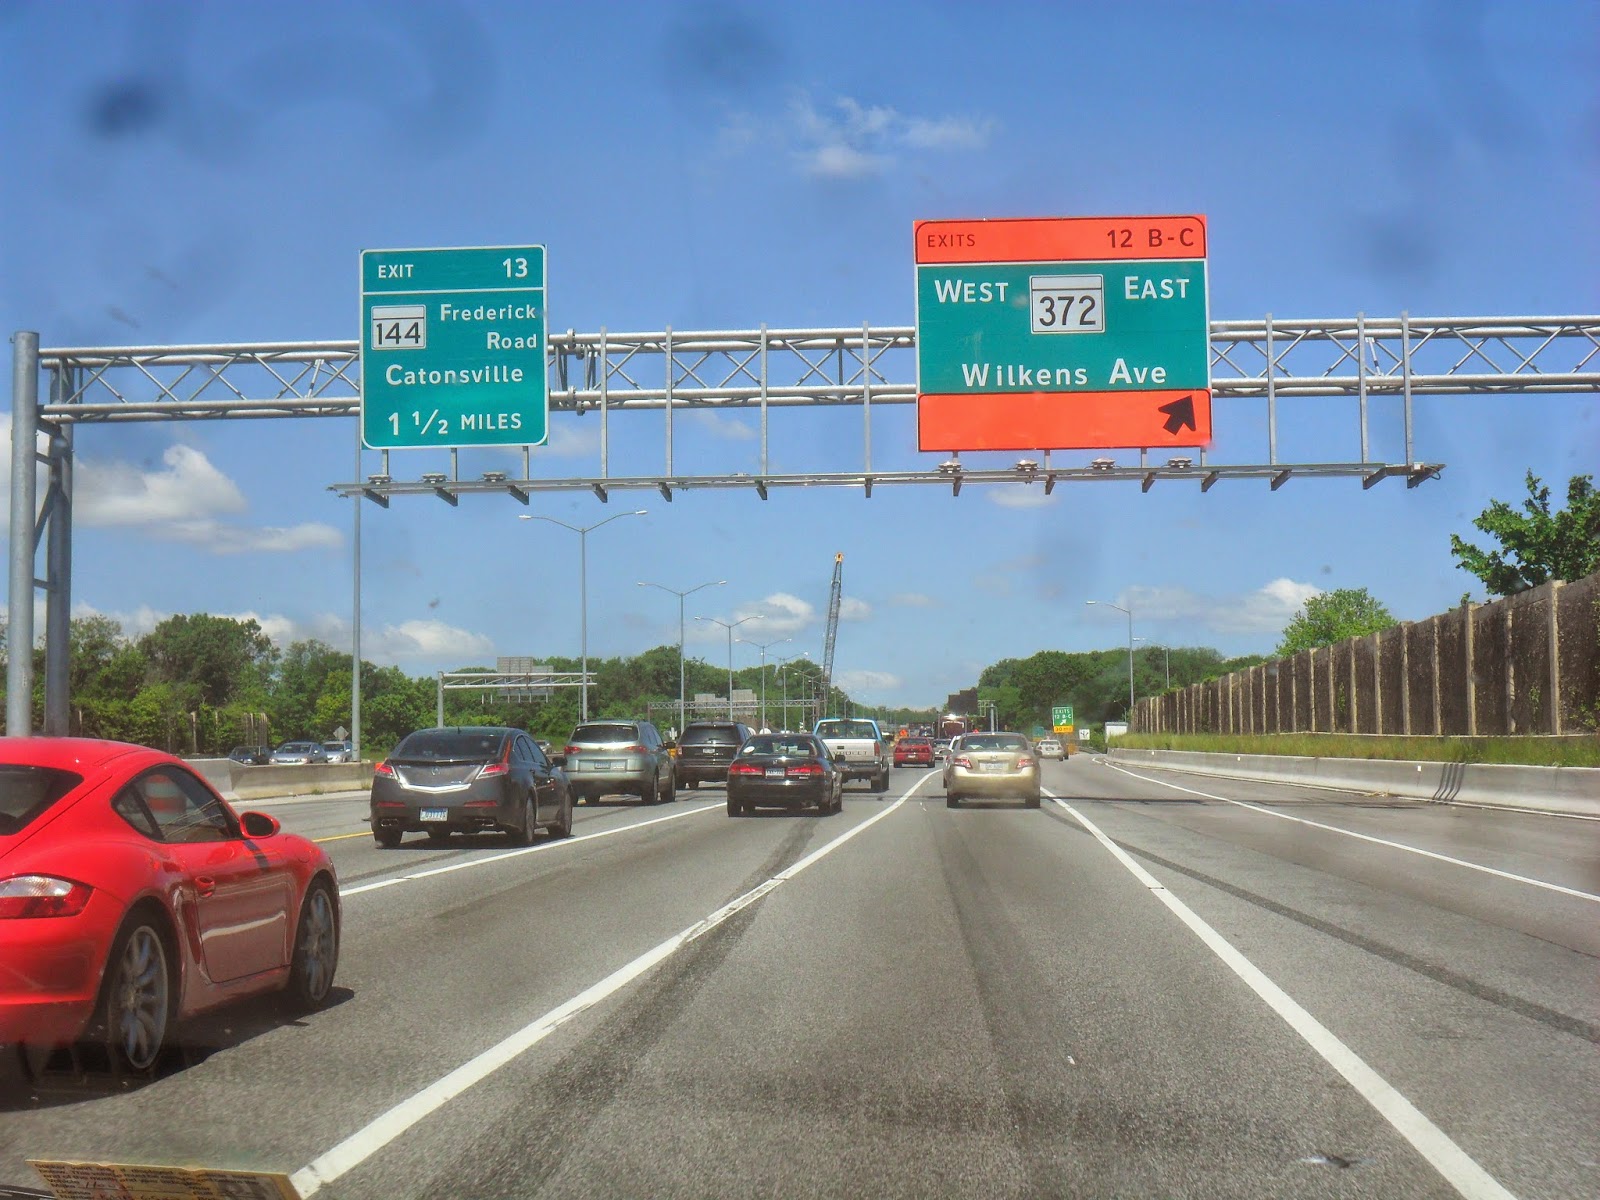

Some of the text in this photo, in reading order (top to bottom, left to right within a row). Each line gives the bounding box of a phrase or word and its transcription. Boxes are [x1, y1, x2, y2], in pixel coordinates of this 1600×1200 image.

[927, 228, 1194, 248] EXITS 12 B-C
[378, 257, 528, 279] EXIT 13
[440, 304, 536, 321] Frederick
[934, 276, 1190, 327] WEST 372 EAST
[376, 322, 421, 345] 144
[487, 331, 537, 350] Road
[385, 364, 524, 386] Catonsville
[961, 358, 1167, 388] Wilkens Ave
[388, 412, 399, 436] 1
[461, 412, 522, 430] MILES
